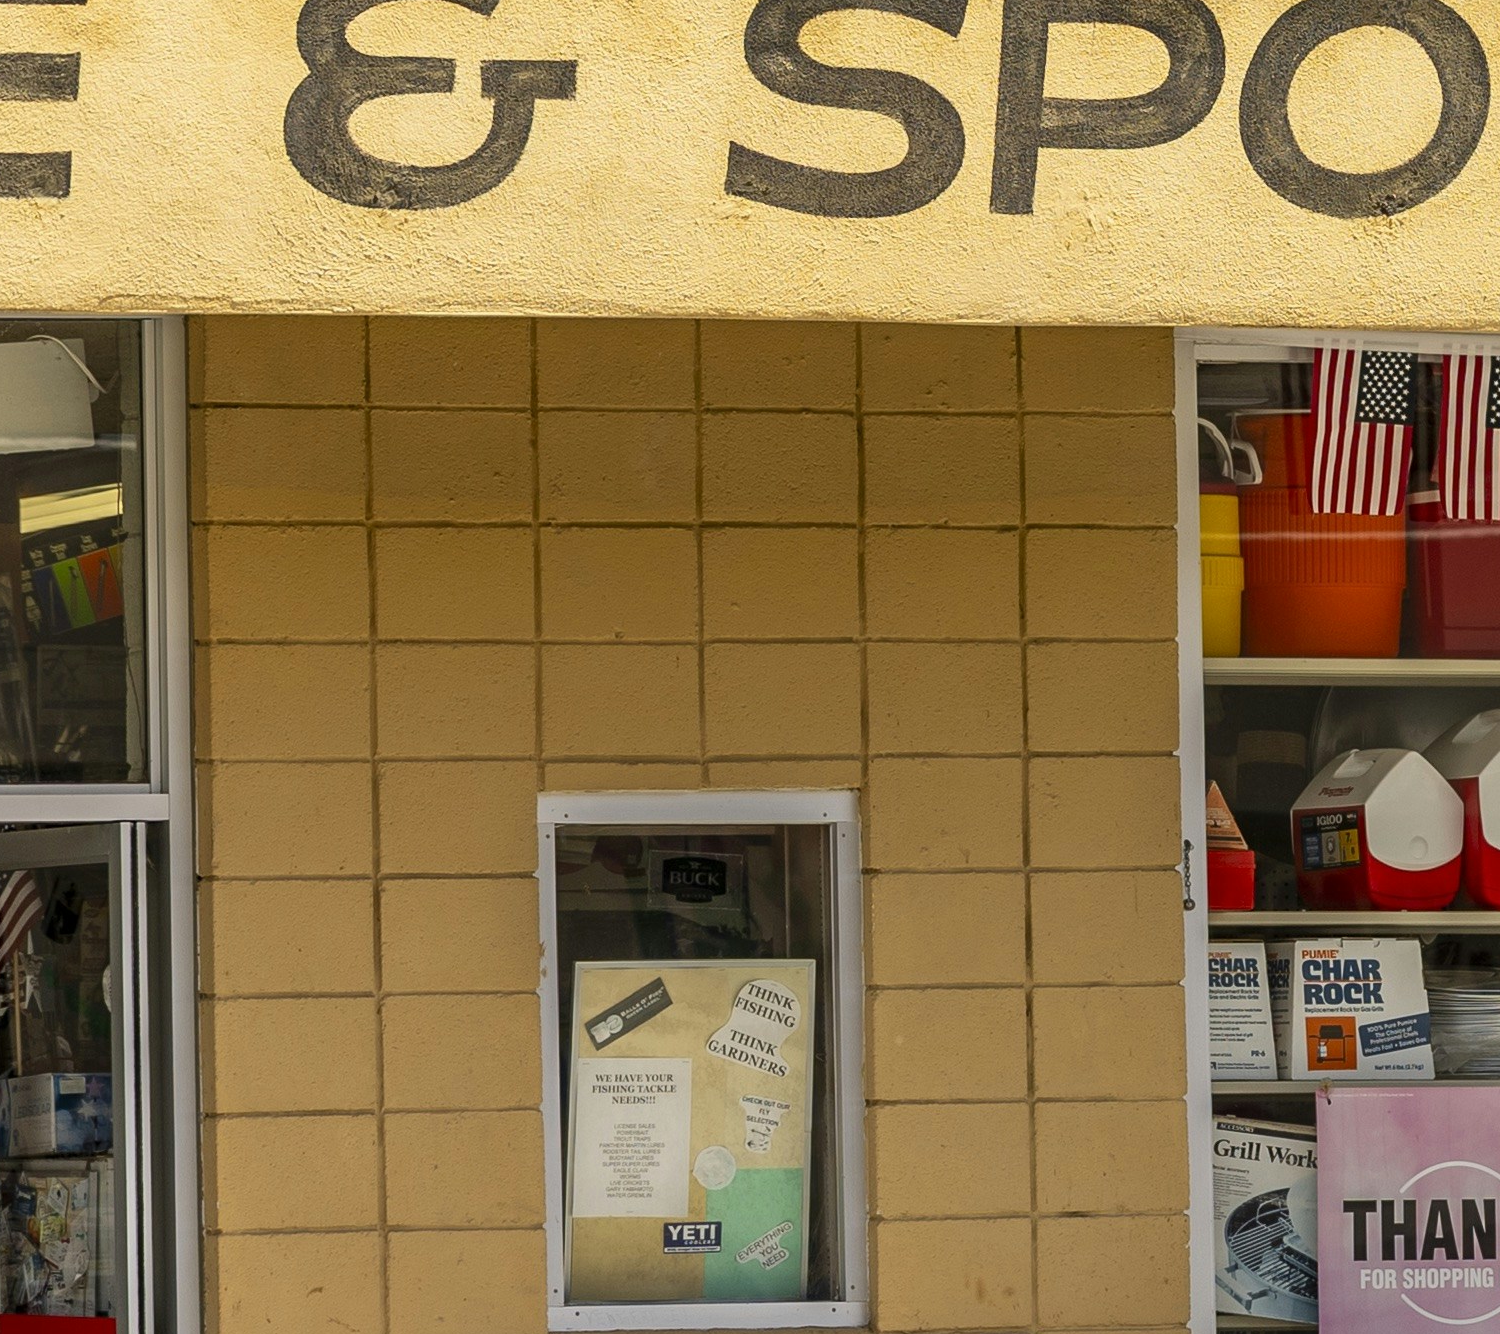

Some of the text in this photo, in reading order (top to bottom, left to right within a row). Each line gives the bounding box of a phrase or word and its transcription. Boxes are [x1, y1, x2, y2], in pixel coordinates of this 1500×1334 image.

[1316, 813, 1343, 826] IGLOO
[669, 871, 720, 886] BUCK
[1301, 949, 1338, 959] PUMIE
[1208, 958, 1258, 973] CHAR
[1301, 959, 1382, 982] CHAR
[1208, 973, 1260, 988] ROCK
[747, 983, 795, 1011] THINK
[1303, 983, 1384, 1005] ROCK
[734, 996, 796, 1029] FISHING
[730, 1029, 778, 1057] THINK
[708, 1039, 788, 1078] GARDNERS
[595, 1074, 674, 1082] WE HAVE YOUR
[592, 1085, 677, 1093] FISHING TACKLE
[611, 1096, 656, 1104] NEEDS!!!
[746, 1115, 779, 1127] SELECTION
[1213, 1139, 1261, 1161] Grill
[668, 1224, 718, 1241] YETI
[737, 1223, 792, 1261] EVERYTHING
[759, 1242, 779, 1258] YOU
[762, 1250, 787, 1269] NEED
[1360, 1267, 1397, 1289] FOR
[1402, 1268, 1494, 1290] SHOPPING
